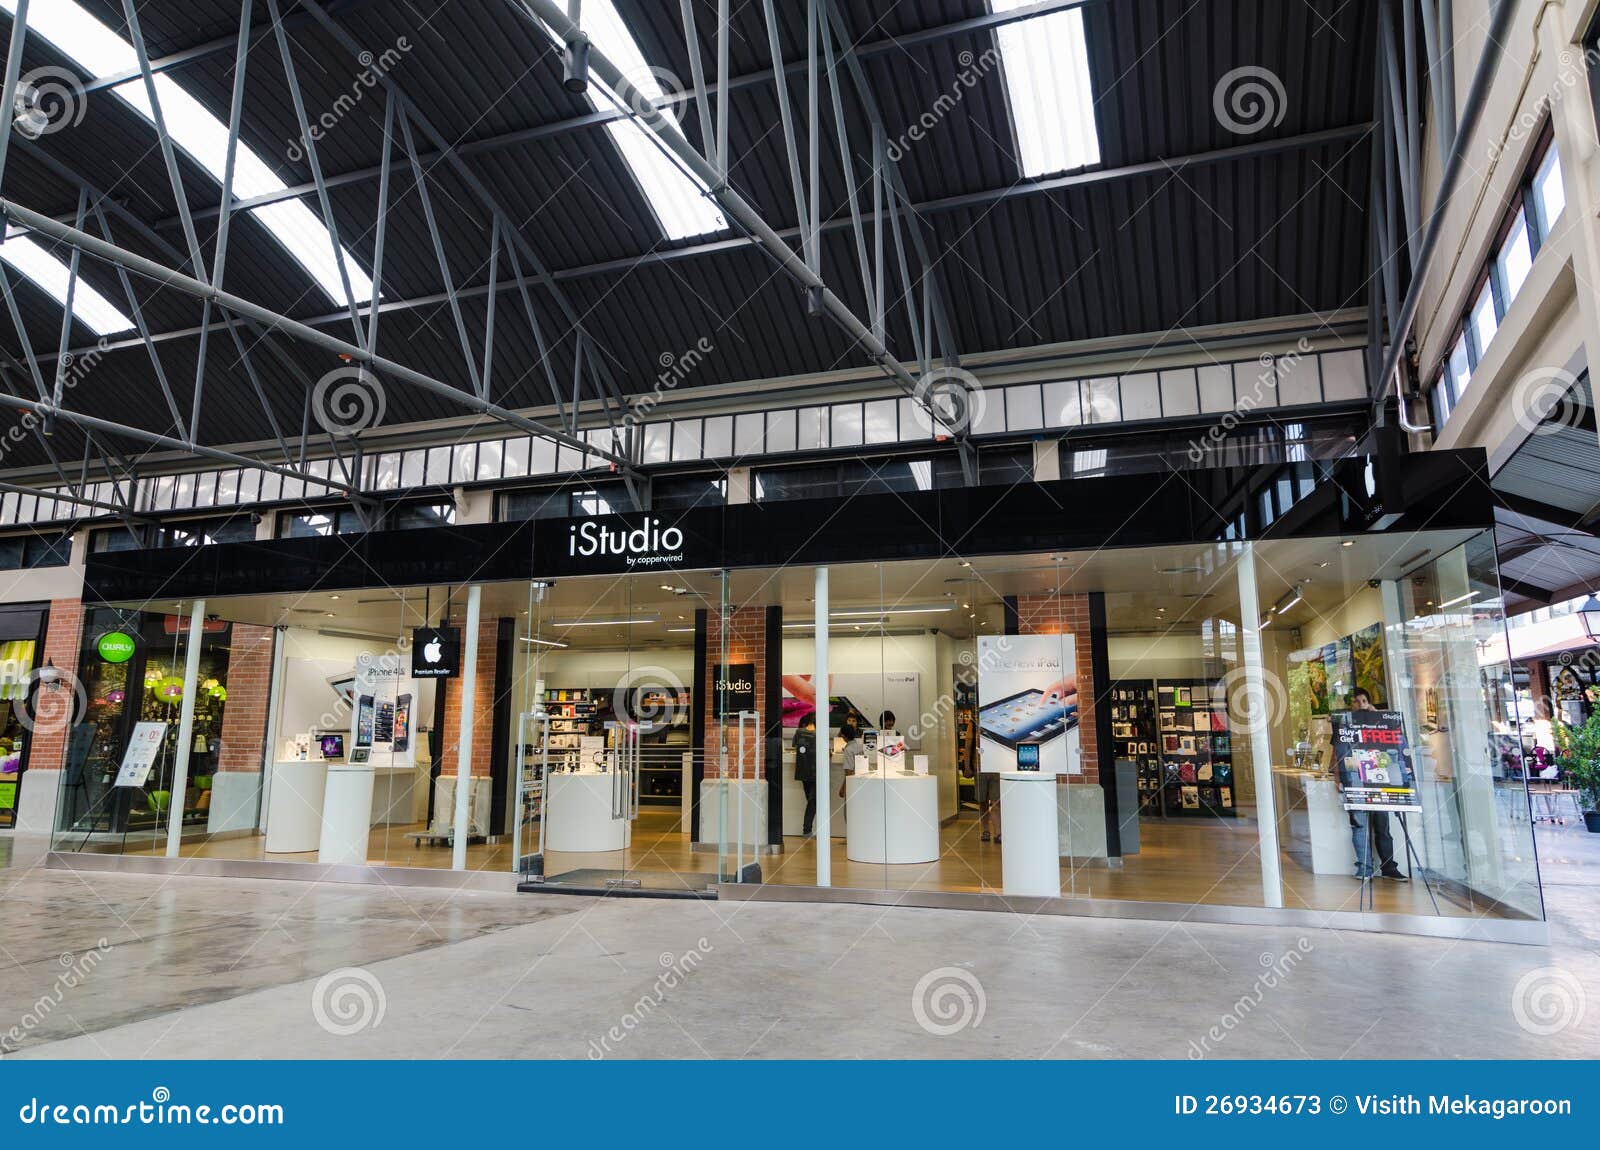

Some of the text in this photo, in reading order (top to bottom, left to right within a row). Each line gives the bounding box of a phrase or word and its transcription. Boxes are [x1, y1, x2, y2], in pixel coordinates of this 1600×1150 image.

[569, 517, 683, 556] iStudio
[626, 552, 683, 566] by copperwired
[715, 678, 752, 690] iStudio
[1339, 728, 1355, 737] Buy
[1340, 735, 1354, 743] Get
[1361, 729, 1402, 744] FREE
